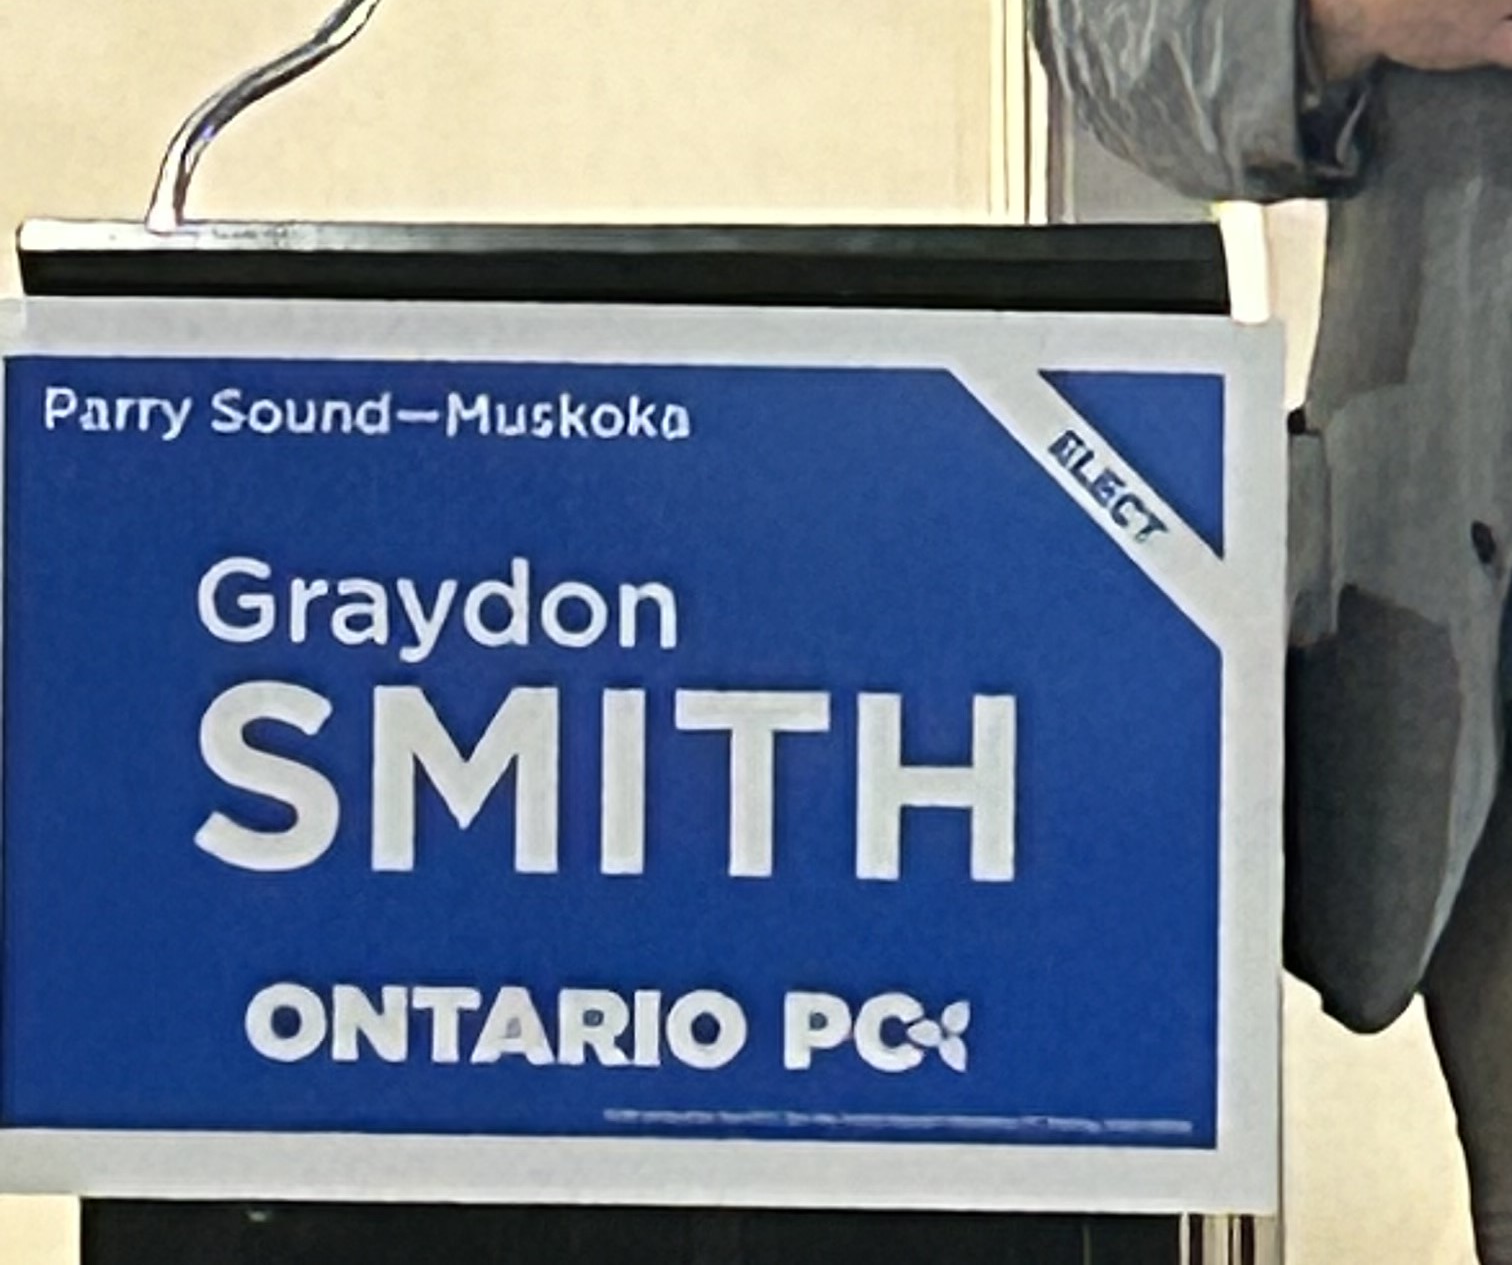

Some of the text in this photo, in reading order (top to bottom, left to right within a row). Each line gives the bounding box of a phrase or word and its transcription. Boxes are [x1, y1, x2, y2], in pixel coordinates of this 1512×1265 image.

[45, 387, 192, 440] Parry
[1047, 430, 1169, 543] ELECT
[198, 557, 677, 663] Graydon
[195, 680, 1016, 882] SMITH
[245, 983, 925, 1073] ONTARIO PC
